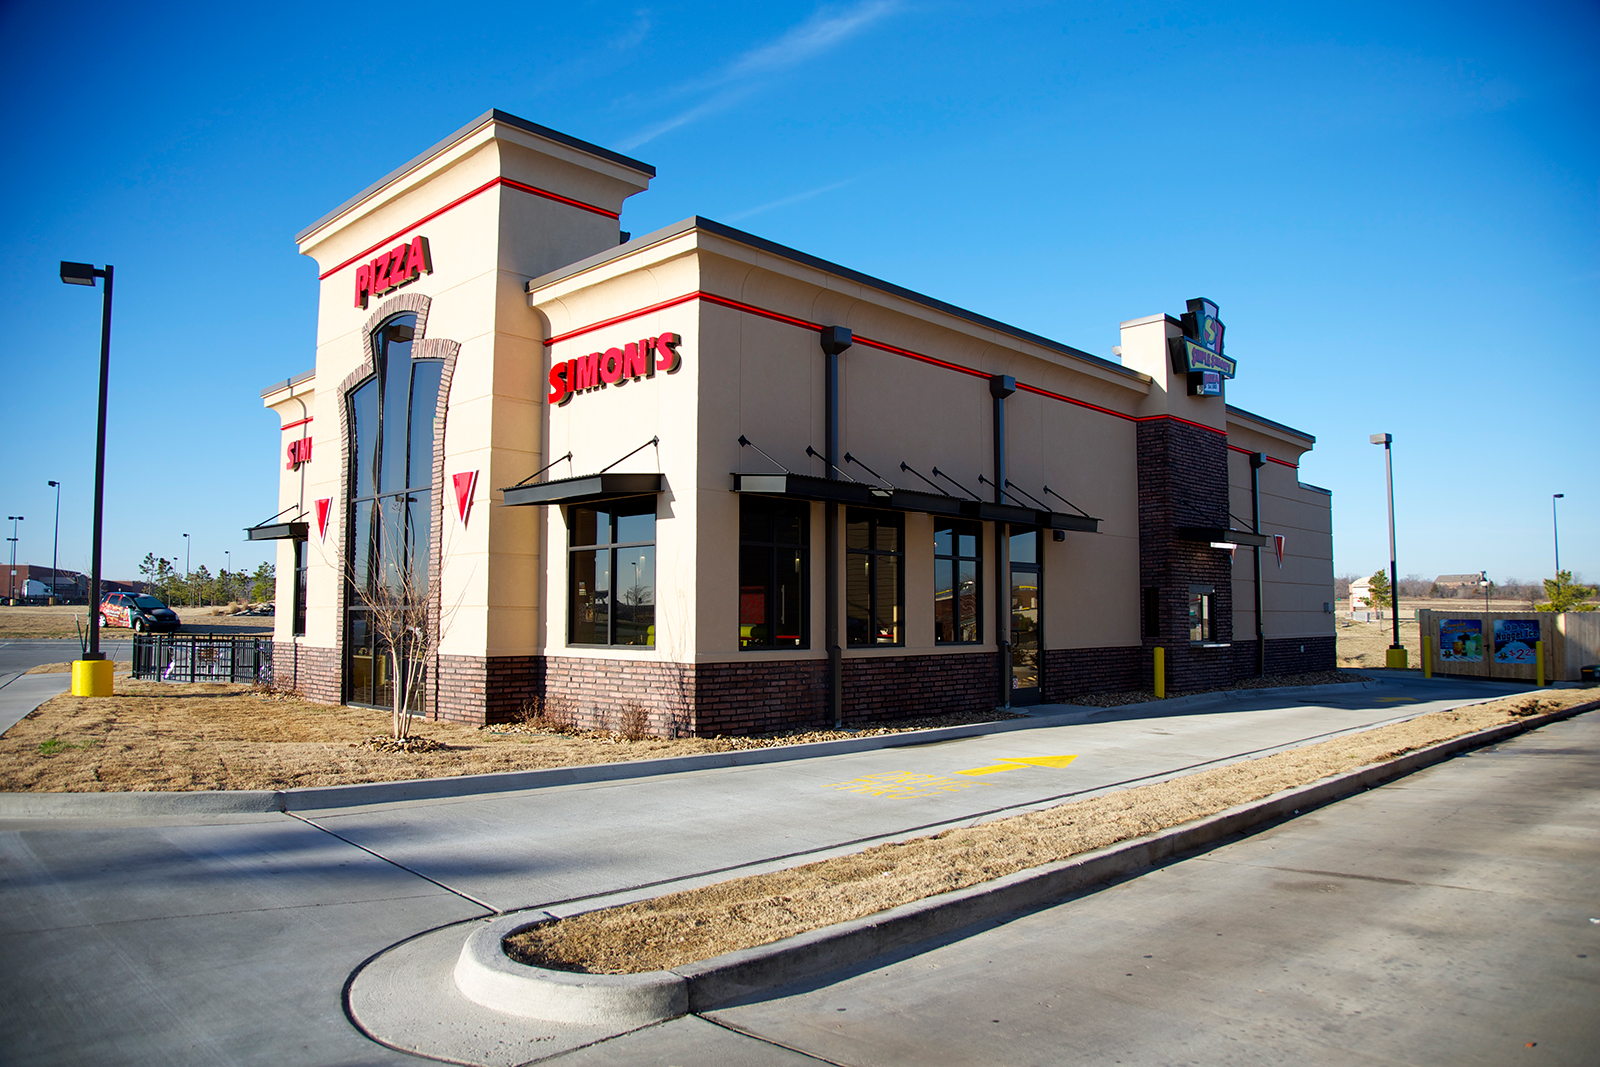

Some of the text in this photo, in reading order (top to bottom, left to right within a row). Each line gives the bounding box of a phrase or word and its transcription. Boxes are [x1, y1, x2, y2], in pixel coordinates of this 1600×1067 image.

[354, 235, 430, 308] PIZZA
[548, 332, 680, 405] SIMON'S
[1495, 630, 1538, 642] Nugget Ice
[820, 778, 944, 800] THRU
[861, 770, 994, 792] DRIVE
